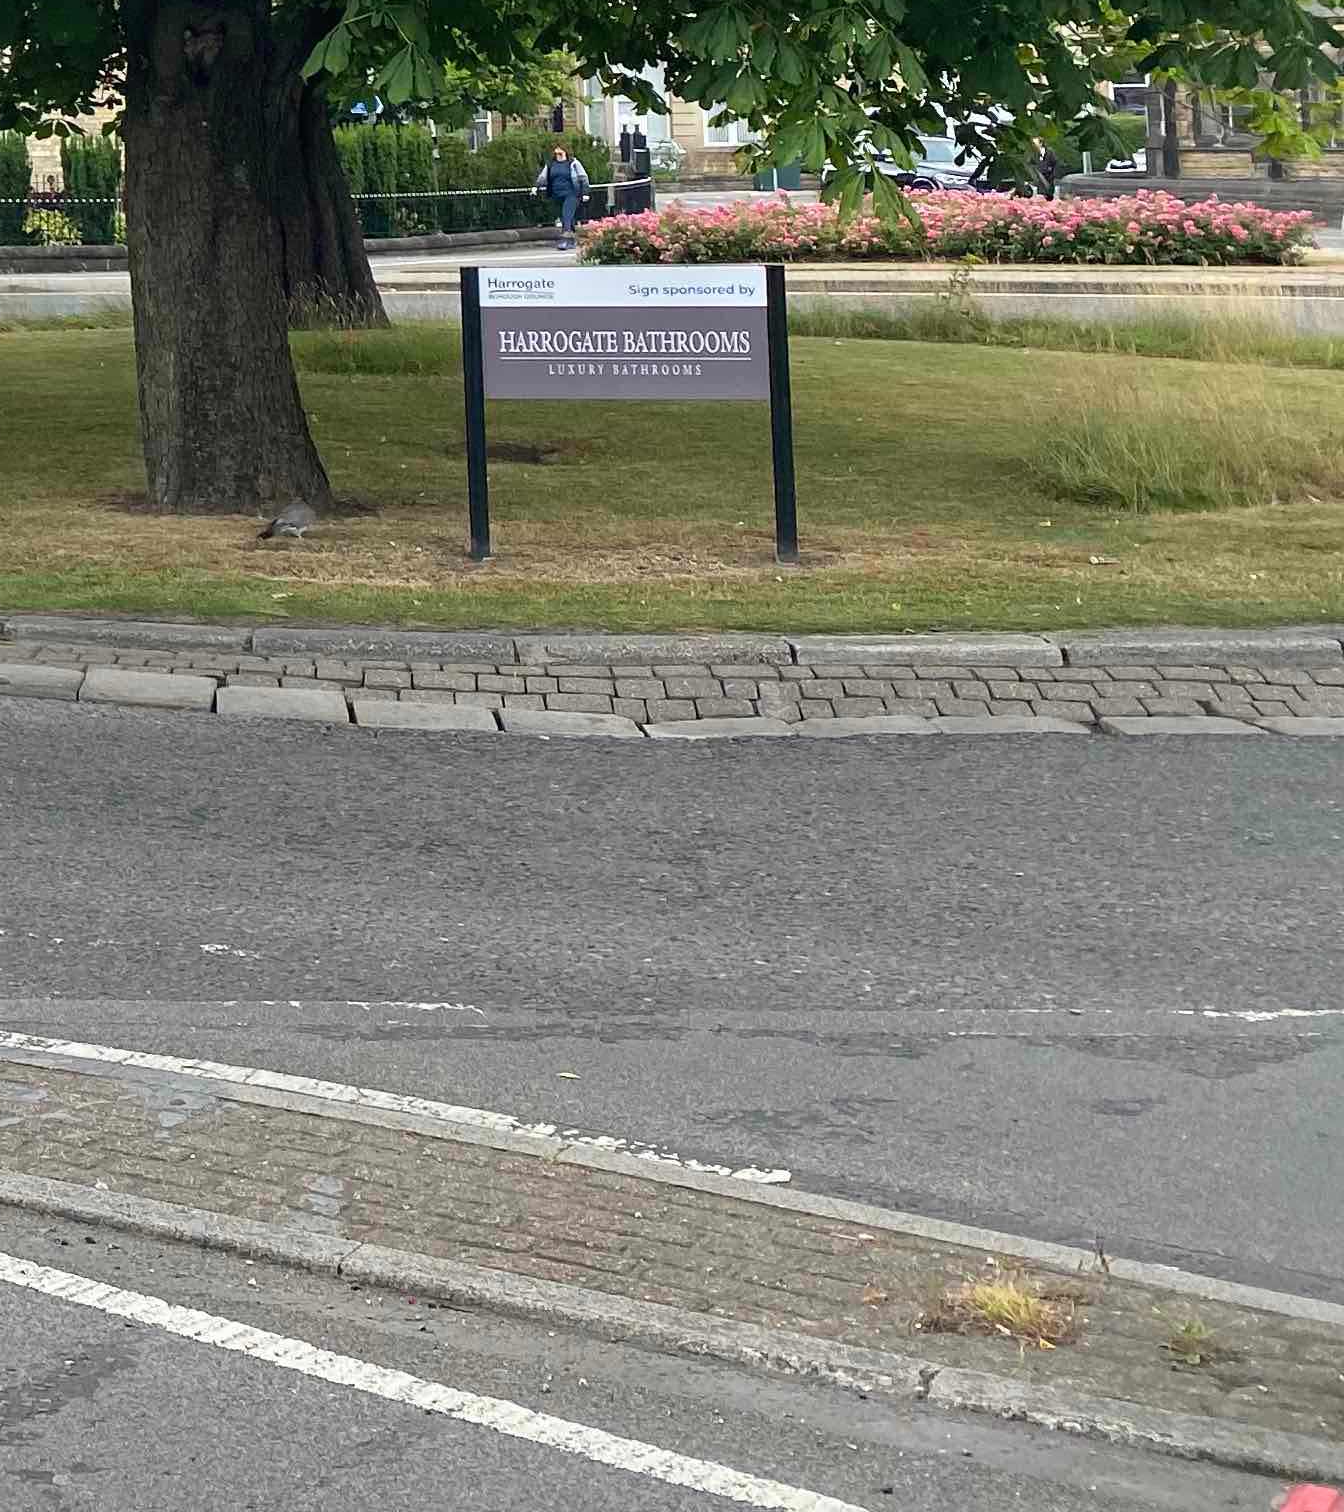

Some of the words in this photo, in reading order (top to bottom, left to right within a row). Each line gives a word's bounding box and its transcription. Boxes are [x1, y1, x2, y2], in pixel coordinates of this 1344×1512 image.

[488, 277, 555, 290] Harrogate
[628, 284, 659, 297] Sign
[662, 284, 735, 297] sponsored
[738, 284, 756, 297] by
[498, 330, 619, 354] HARROGATE
[622, 330, 751, 354] BATHROOMS
[548, 363, 605, 376] LUXURY
[612, 363, 703, 376] BATHROOMS
